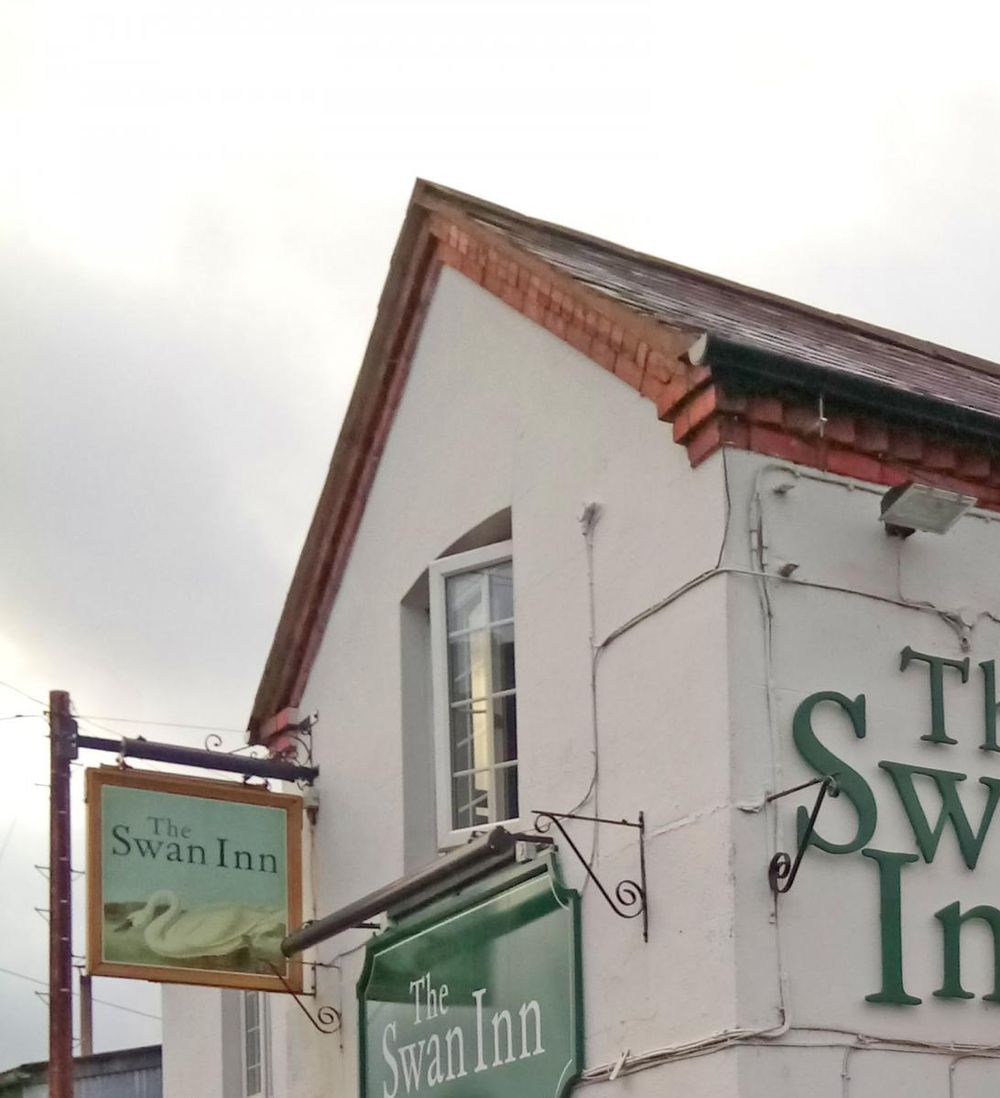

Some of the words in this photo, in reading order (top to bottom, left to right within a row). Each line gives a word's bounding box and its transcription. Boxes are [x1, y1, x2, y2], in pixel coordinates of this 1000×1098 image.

[111, 824, 207, 865] Swan
[216, 837, 279, 874] Inn
[147, 816, 192, 839] The
[409, 971, 449, 1025] The
[472, 988, 545, 1073] Inn
